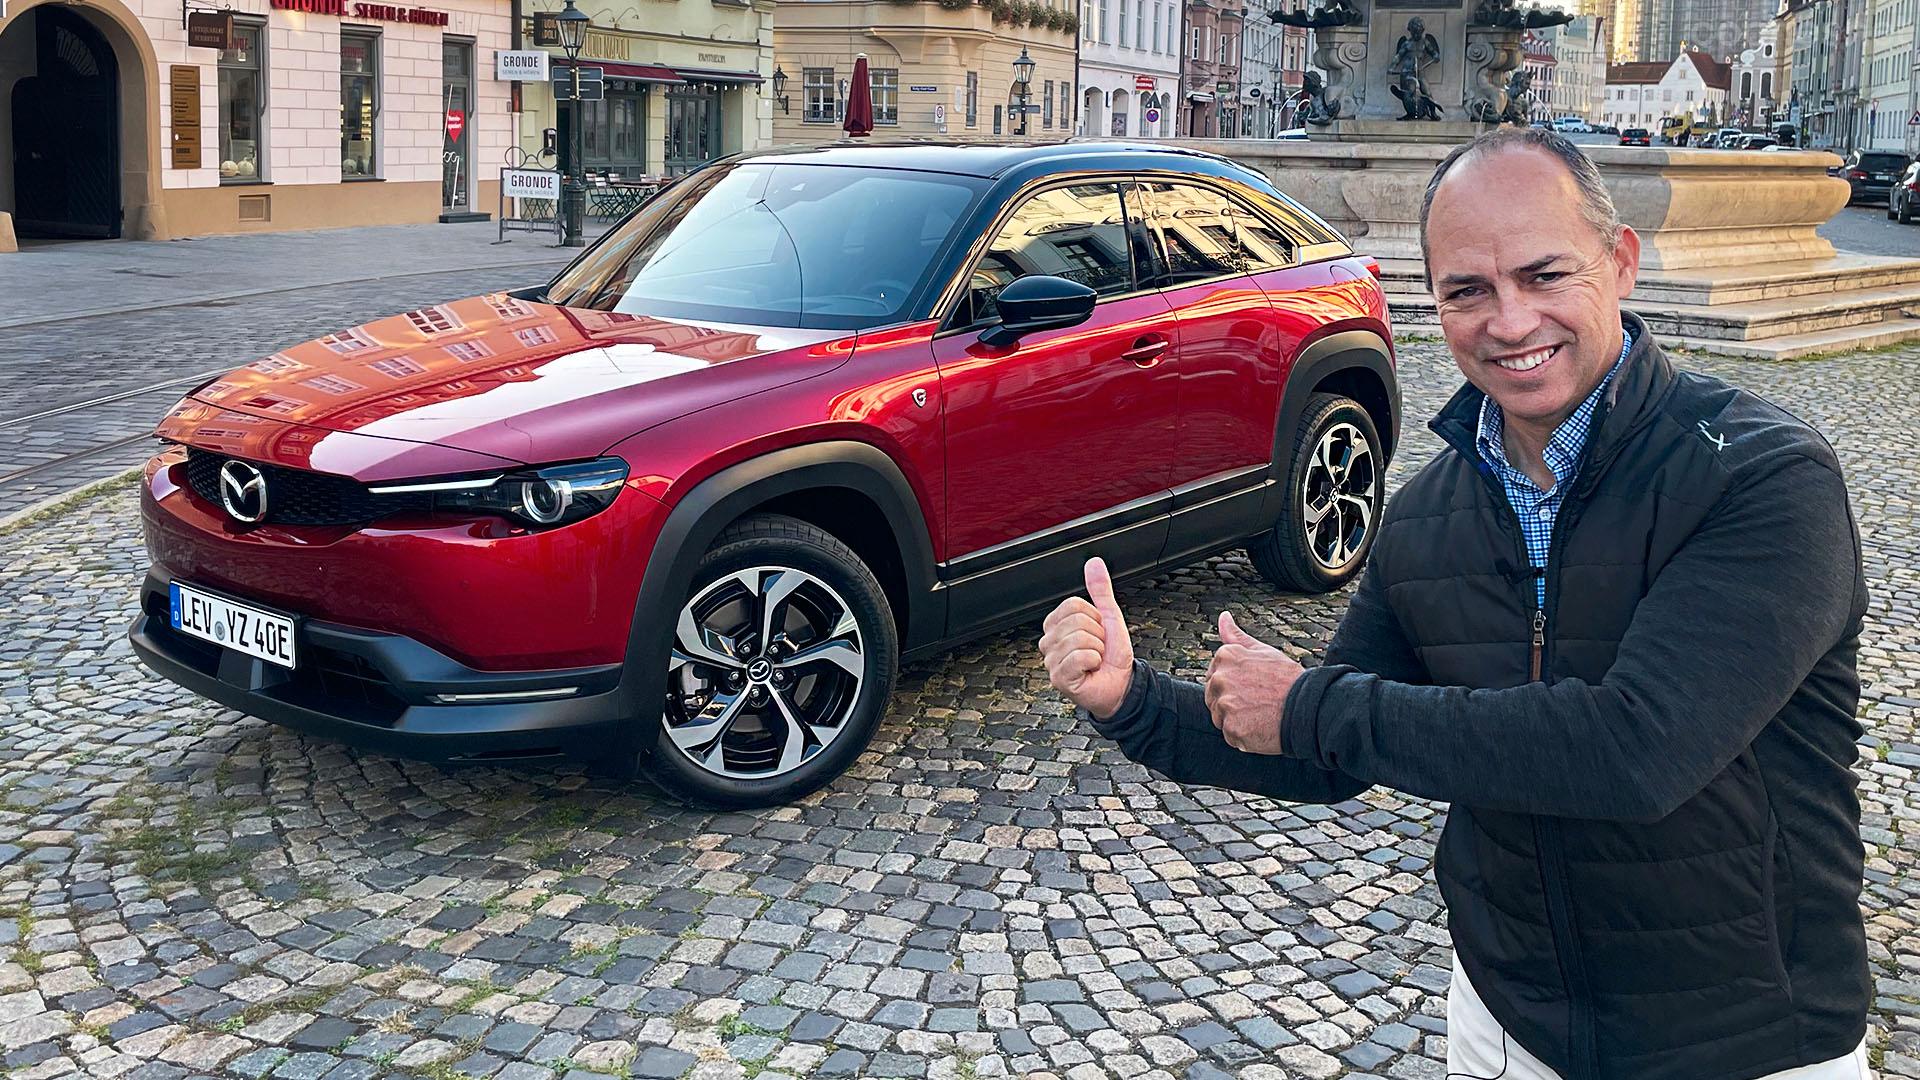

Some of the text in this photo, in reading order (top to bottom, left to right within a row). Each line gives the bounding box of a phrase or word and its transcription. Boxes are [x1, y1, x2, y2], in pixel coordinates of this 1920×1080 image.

[503, 55, 539, 68] GRONDE
[511, 174, 553, 189] GRONDE
[174, 611, 179, 621] D
[181, 593, 290, 661] LEV YZ 40E
